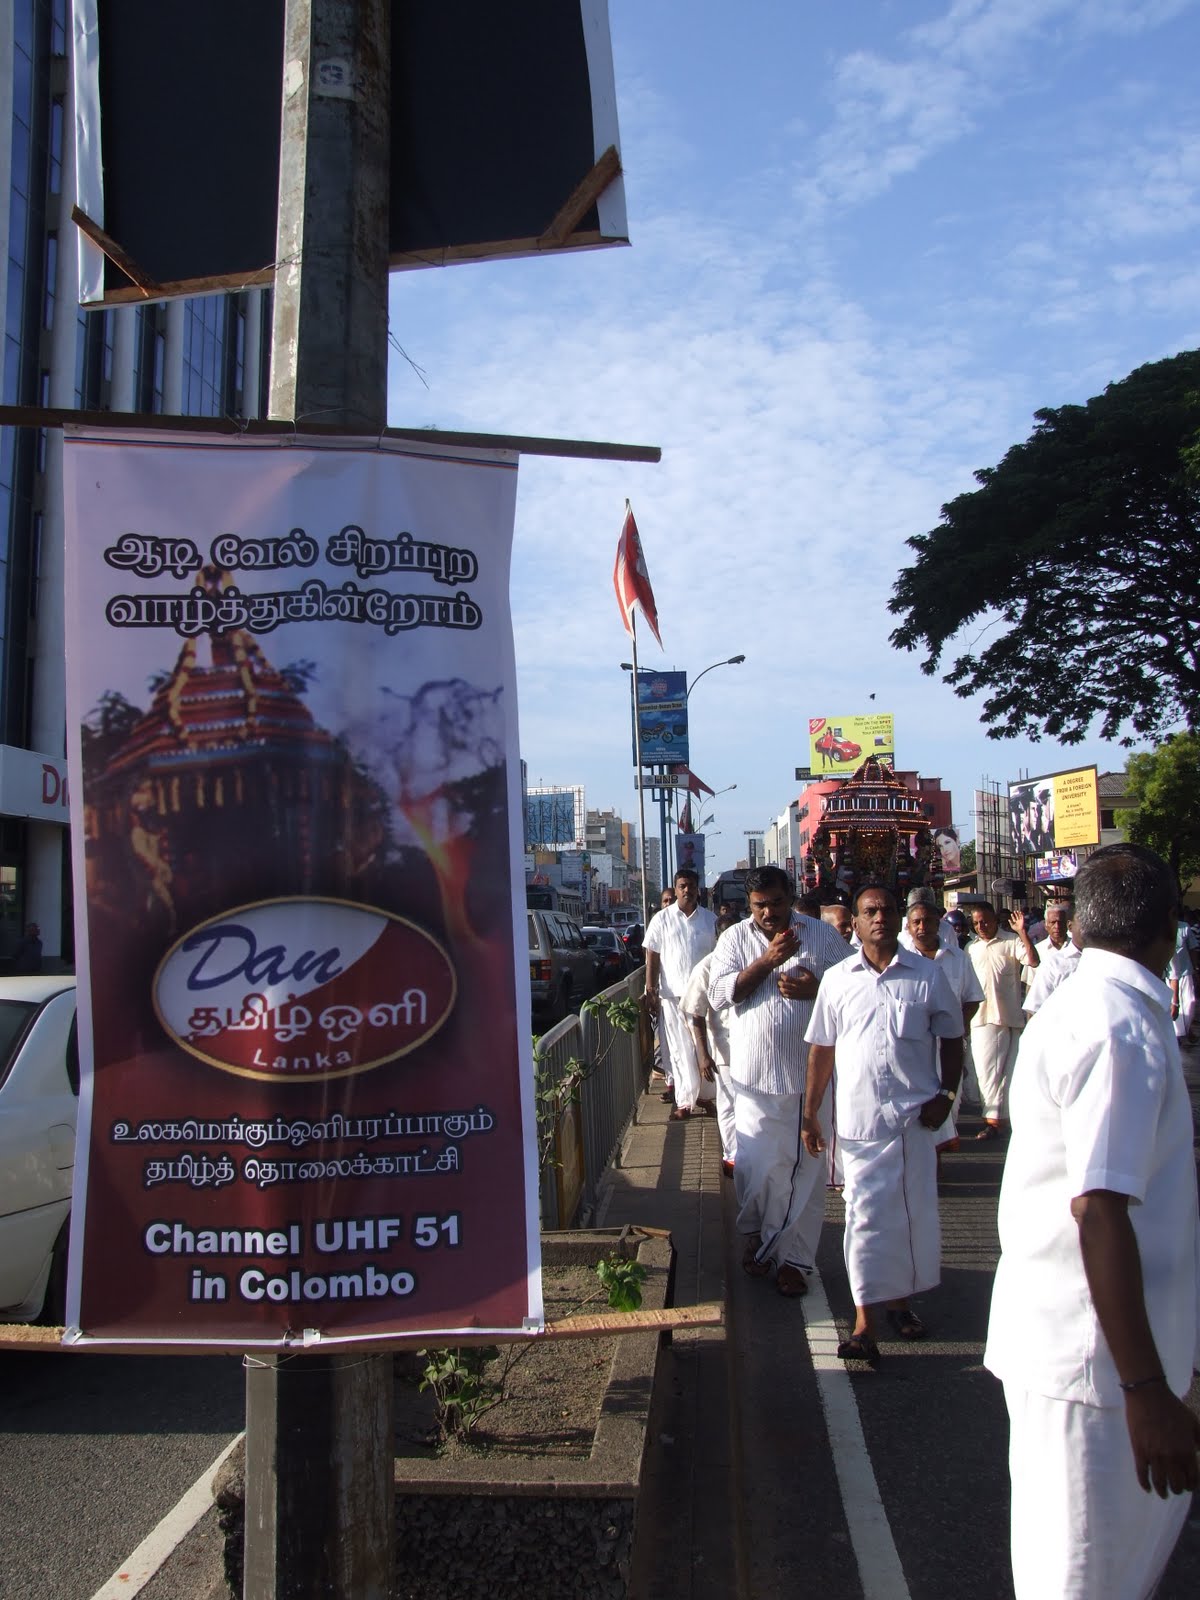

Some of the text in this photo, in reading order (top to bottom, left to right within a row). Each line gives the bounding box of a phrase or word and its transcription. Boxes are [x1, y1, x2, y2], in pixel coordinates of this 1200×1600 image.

[108, 530, 475, 582] ஆடி வேல் சிறப்புற
[109, 584, 480, 634] வாழ்த்துகின்றோம்
[654, 774, 679, 785] HNB
[1062, 791, 1087, 800] UNIVERSITY
[1067, 776, 1084, 785] DEGREE
[1073, 783, 1092, 791] FOREIGN
[182, 924, 342, 991] Dan
[253, 1048, 351, 1069] Lanka
[145, 1146, 460, 1188] தமிழ்த் தொலைக்காட்சி
[145, 1215, 460, 1256] Channel UHF 51
[191, 1267, 415, 1301] in Colombo
